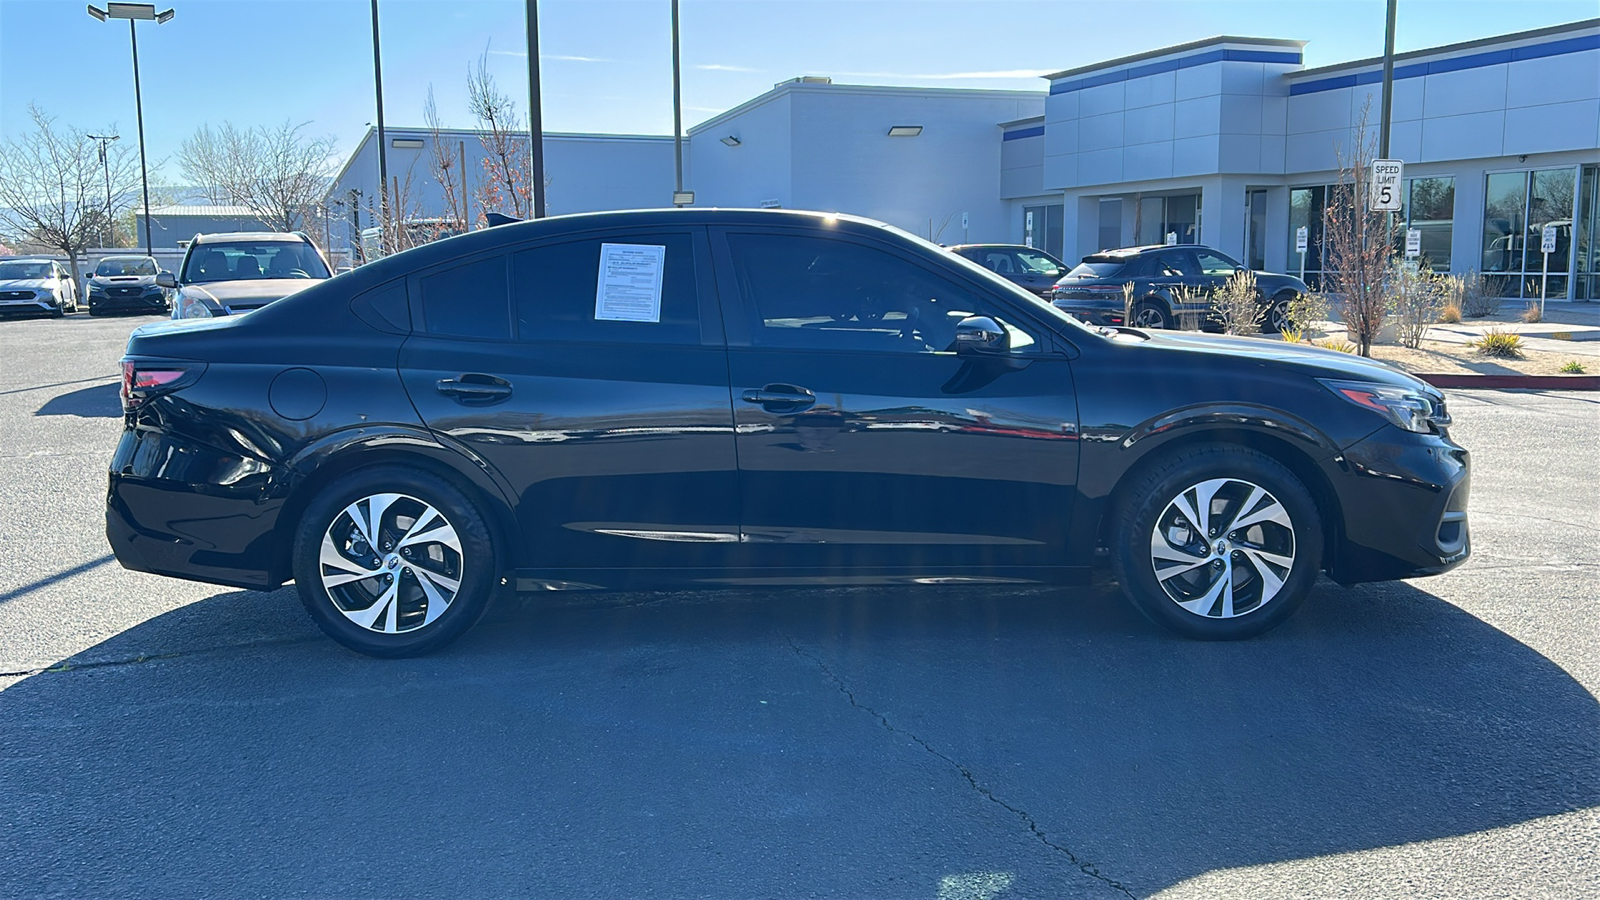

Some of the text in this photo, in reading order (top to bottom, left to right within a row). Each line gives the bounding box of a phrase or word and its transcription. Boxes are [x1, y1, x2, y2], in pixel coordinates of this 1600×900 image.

[1375, 165, 1400, 174] SPEED
[1377, 176, 1396, 184] LIMIT
[1380, 186, 1392, 204] 5
